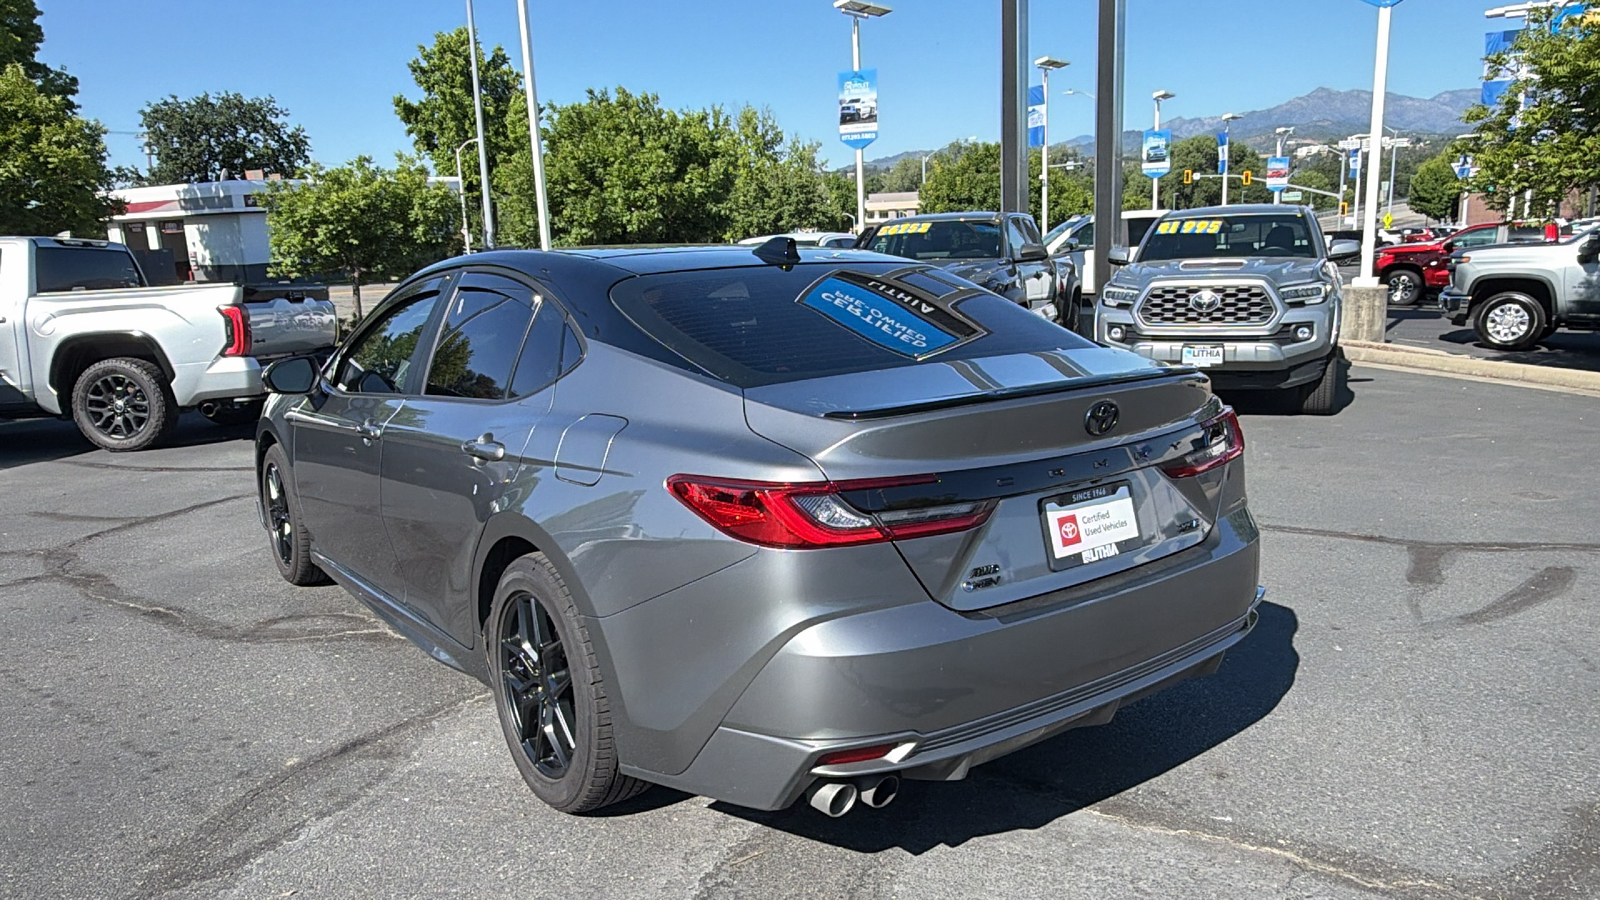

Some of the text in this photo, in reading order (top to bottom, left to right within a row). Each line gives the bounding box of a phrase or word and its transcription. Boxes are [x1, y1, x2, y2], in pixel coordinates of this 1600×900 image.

[1157, 220, 1223, 234] 41995
[1192, 349, 1220, 358] LITHIA
[1072, 488, 1107, 502] SINCE 1946
[1081, 510, 1110, 525] Certified
[1084, 519, 1128, 537] Used Vehicles
[1090, 543, 1119, 562] LITHIA
